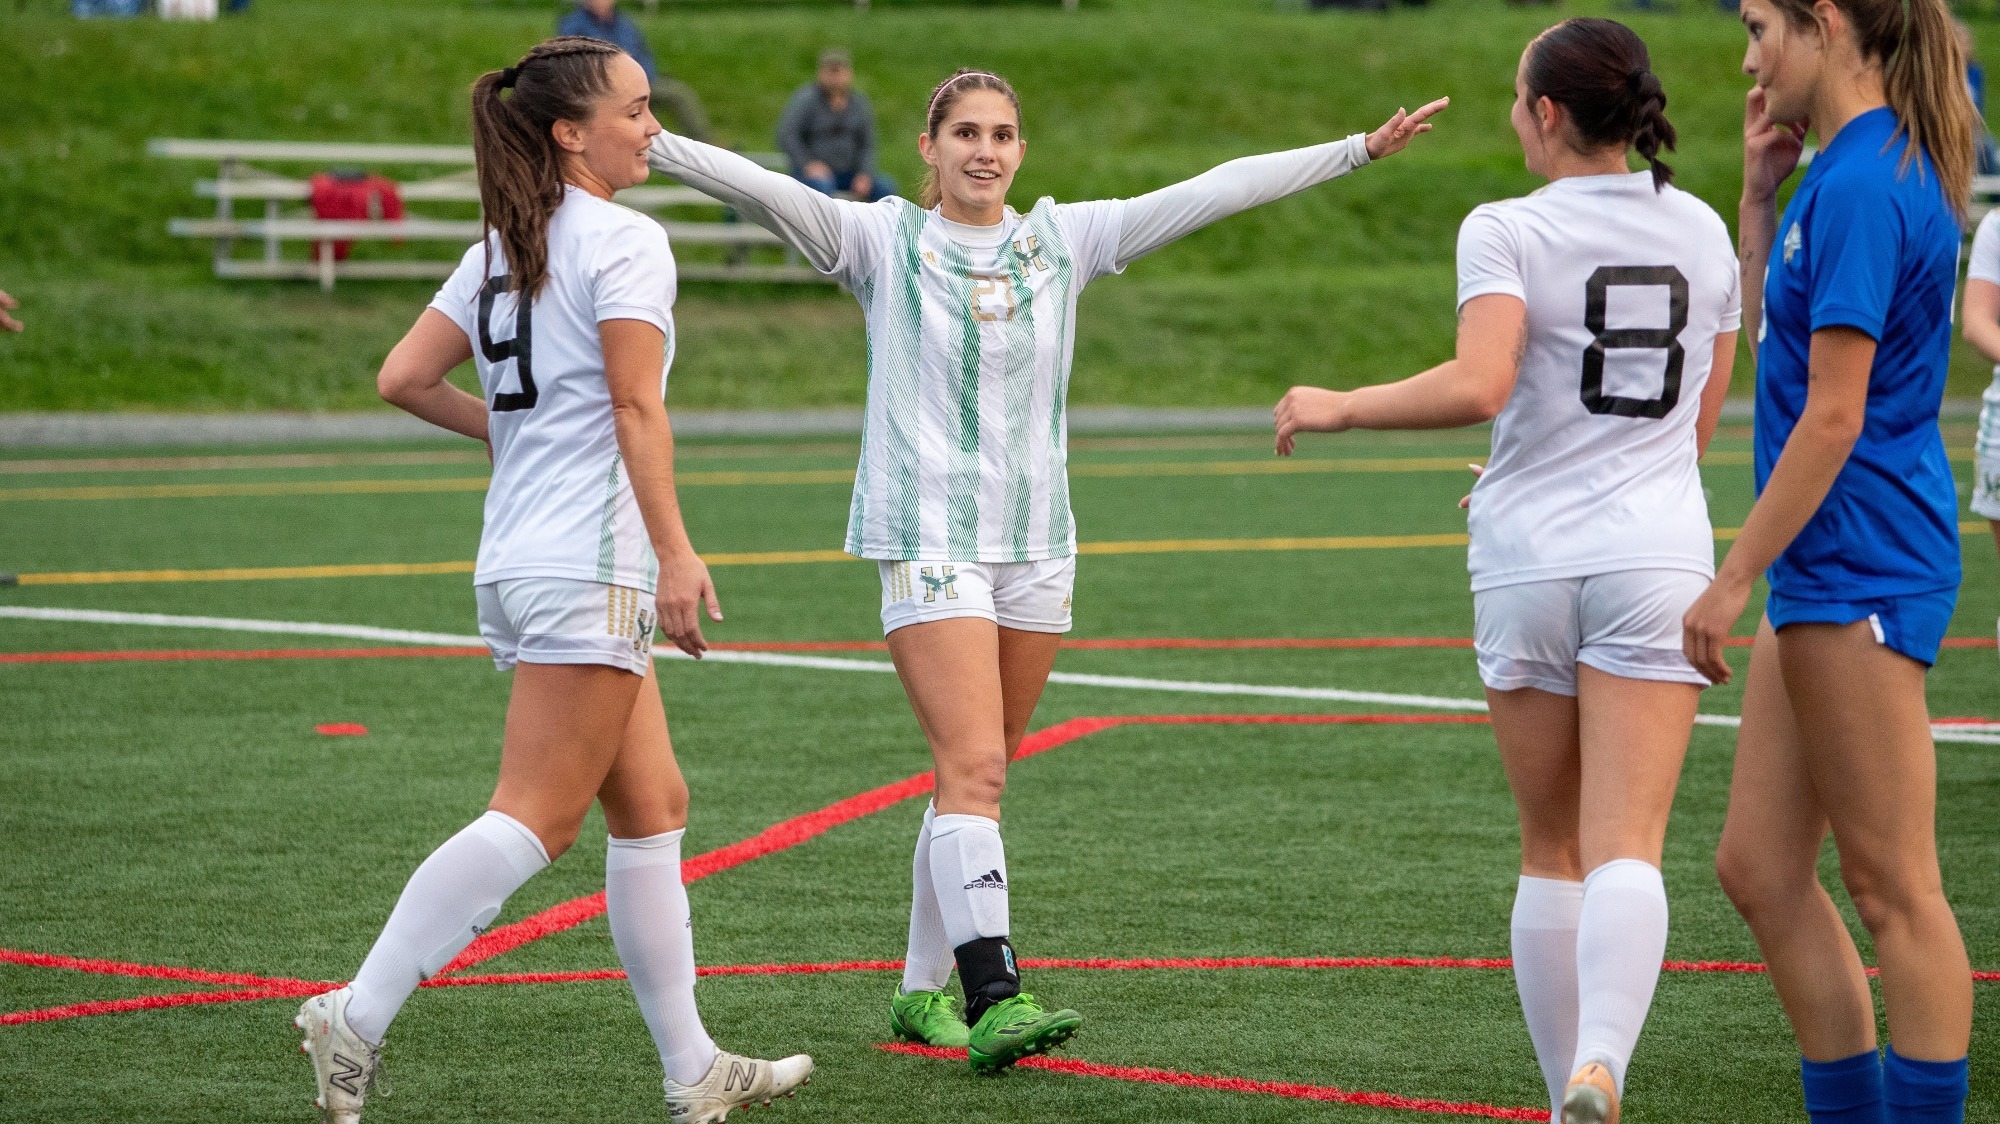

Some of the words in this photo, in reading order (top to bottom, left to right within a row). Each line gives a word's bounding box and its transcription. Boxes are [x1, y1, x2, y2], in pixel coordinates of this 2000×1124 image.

[478, 275, 539, 411] 9
[1580, 265, 1689, 419] 8
[963, 881, 1007, 891] adidas
[724, 1061, 757, 1091] N
